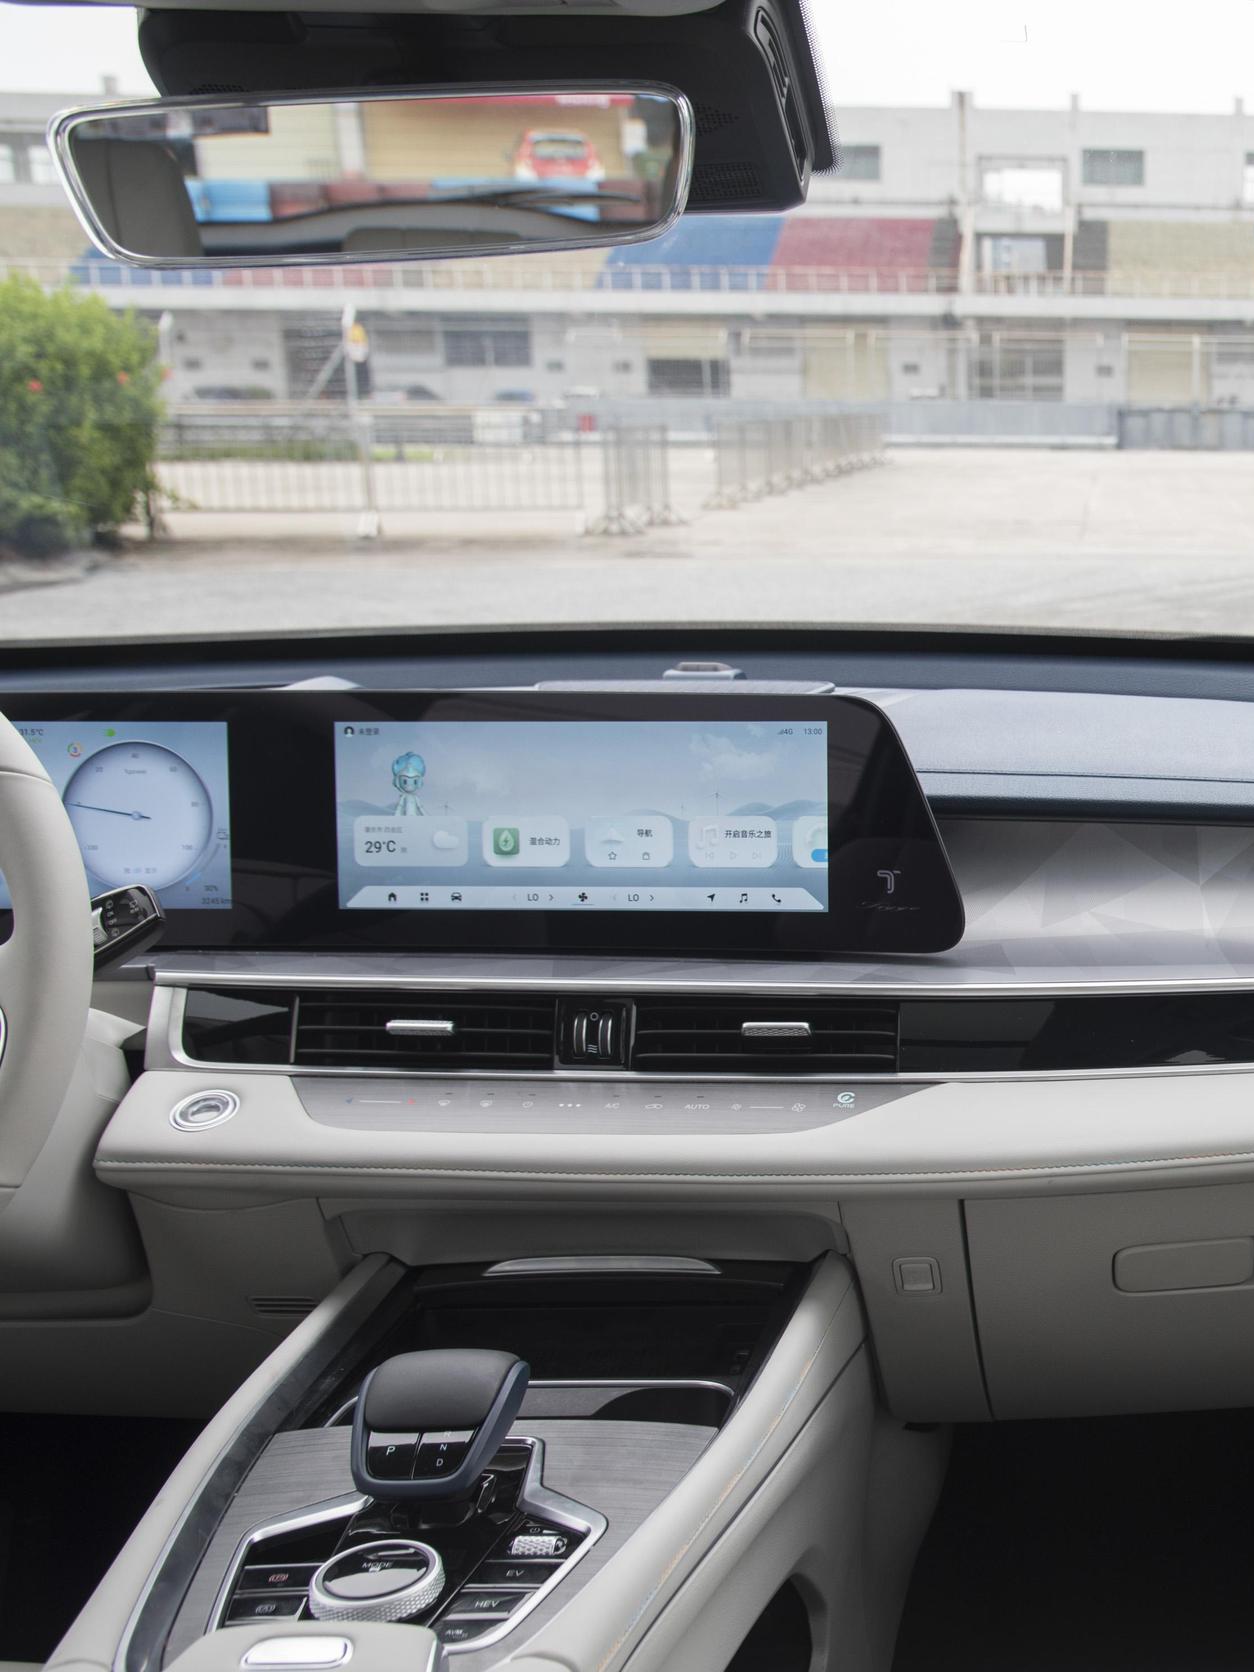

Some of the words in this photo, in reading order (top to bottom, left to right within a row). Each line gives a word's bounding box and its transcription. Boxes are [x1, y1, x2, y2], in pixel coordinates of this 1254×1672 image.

[637, 828, 653, 838] 导航
[724, 829, 772, 839] 开启音乐之旅
[529, 837, 561, 846] 混合动力
[364, 840, 397, 853] 29°C
[527, 893, 539, 902] LO
[627, 893, 640, 902] LO
[684, 1103, 711, 1111] AUTO
[385, 1446, 396, 1456] P
[439, 1443, 448, 1451] N
[436, 1458, 444, 1467] D
[361, 1561, 394, 1569] MODE
[505, 1569, 525, 1577] EV
[474, 1600, 500, 1609] HEV
